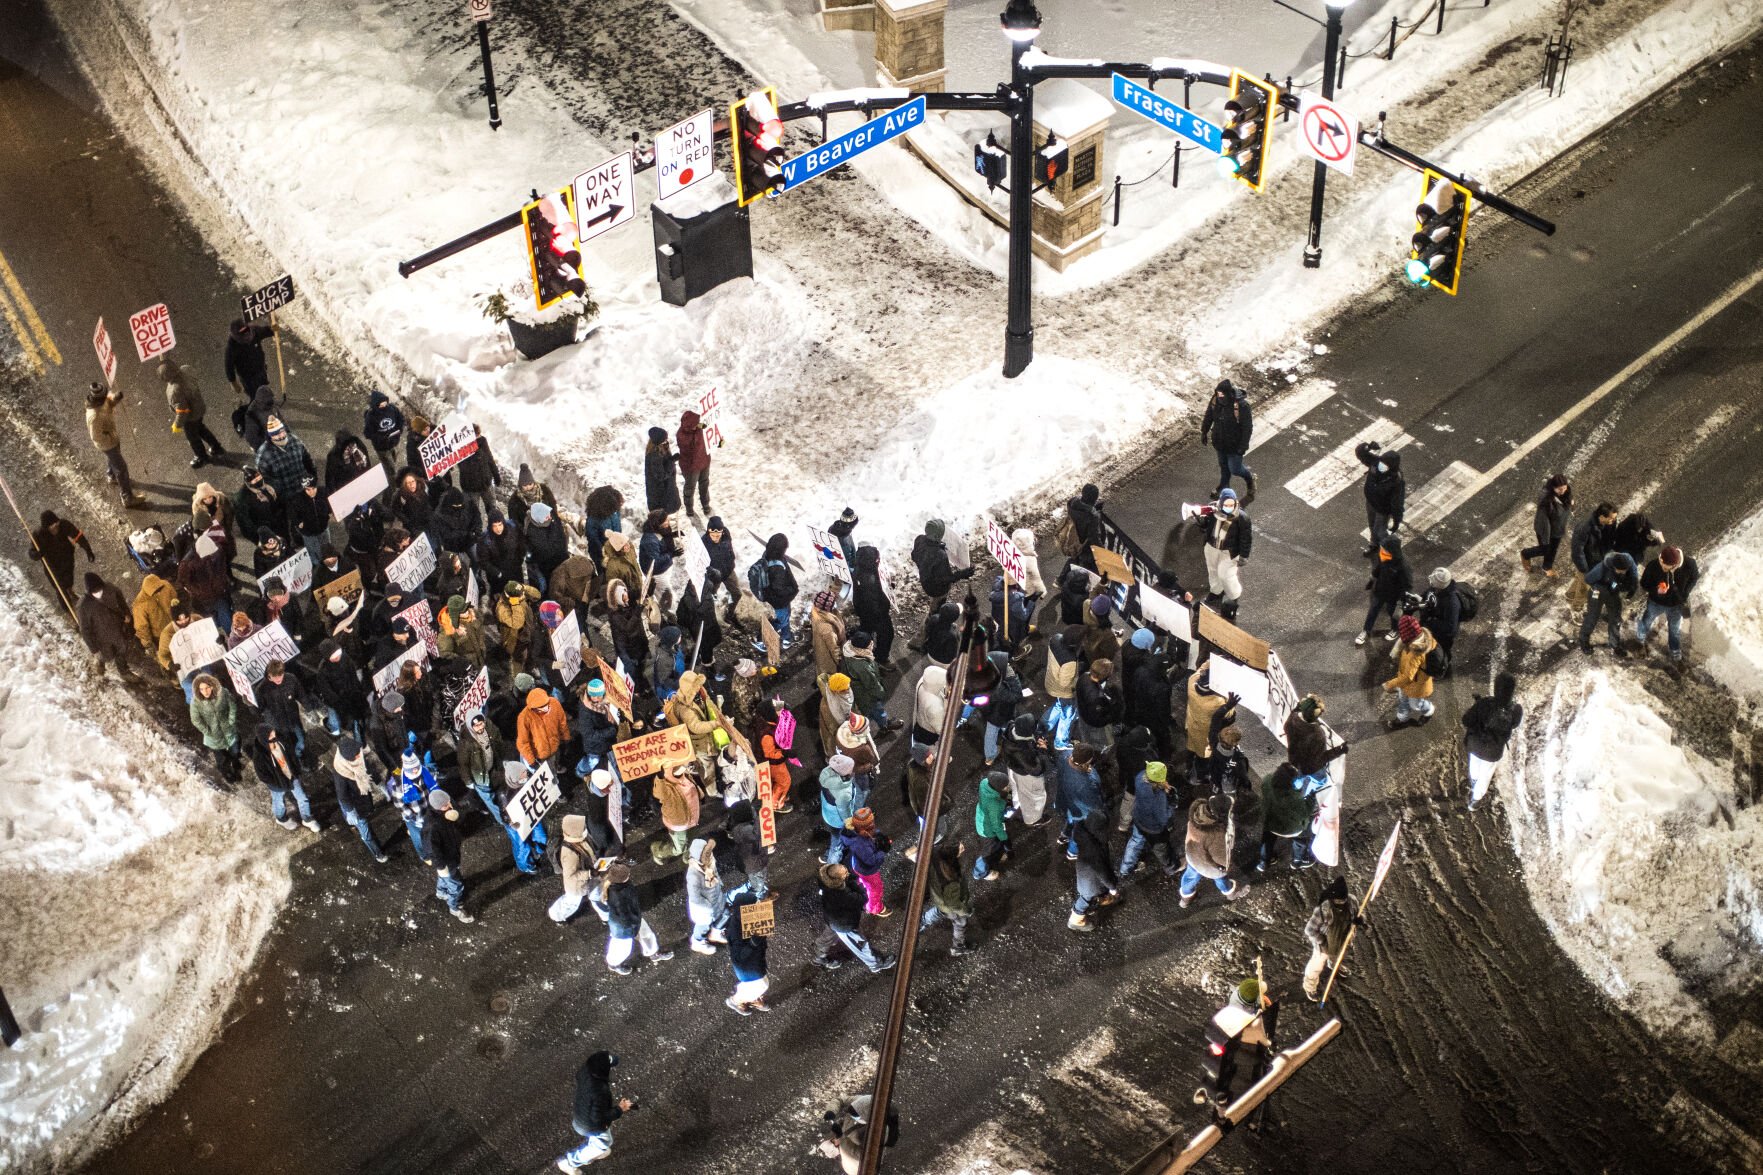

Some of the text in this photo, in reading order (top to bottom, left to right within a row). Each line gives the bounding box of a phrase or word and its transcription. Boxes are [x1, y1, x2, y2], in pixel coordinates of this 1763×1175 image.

[1123, 82, 1211, 143] Fraser St
[673, 121, 695, 142] NO
[806, 127, 874, 172] Beaver
[883, 106, 918, 135] Ave
[670, 134, 701, 158] TURN
[661, 145, 709, 177] ON RED
[586, 163, 621, 191] ONE
[586, 181, 622, 210] WAY
[244, 278, 289, 308] FUCK
[244, 291, 290, 321] TRUMP
[131, 304, 168, 331] DRIVE
[136, 319, 170, 342] OUT
[139, 333, 172, 358] ICE
[699, 387, 719, 416] ICE
[421, 434, 447, 458] SHUT
[424, 444, 453, 468] DOWN
[807, 525, 841, 553] ICE
[989, 520, 1021, 563] FUCK
[289, 551, 308, 567] BACK
[388, 537, 428, 581] END MASS
[988, 534, 1025, 582] TRUMP
[337, 584, 353, 596] ICE
[224, 624, 280, 670] NO ICE
[241, 637, 297, 681] ECRUITMENT
[616, 733, 668, 755] THEY ARE
[617, 740, 686, 766] TREADING ON
[623, 764, 649, 777] YOU
[519, 771, 549, 811] FUCK
[758, 768, 774, 841] ICE OUT
[525, 790, 552, 827] ICE
[744, 919, 773, 930] FIGHT
